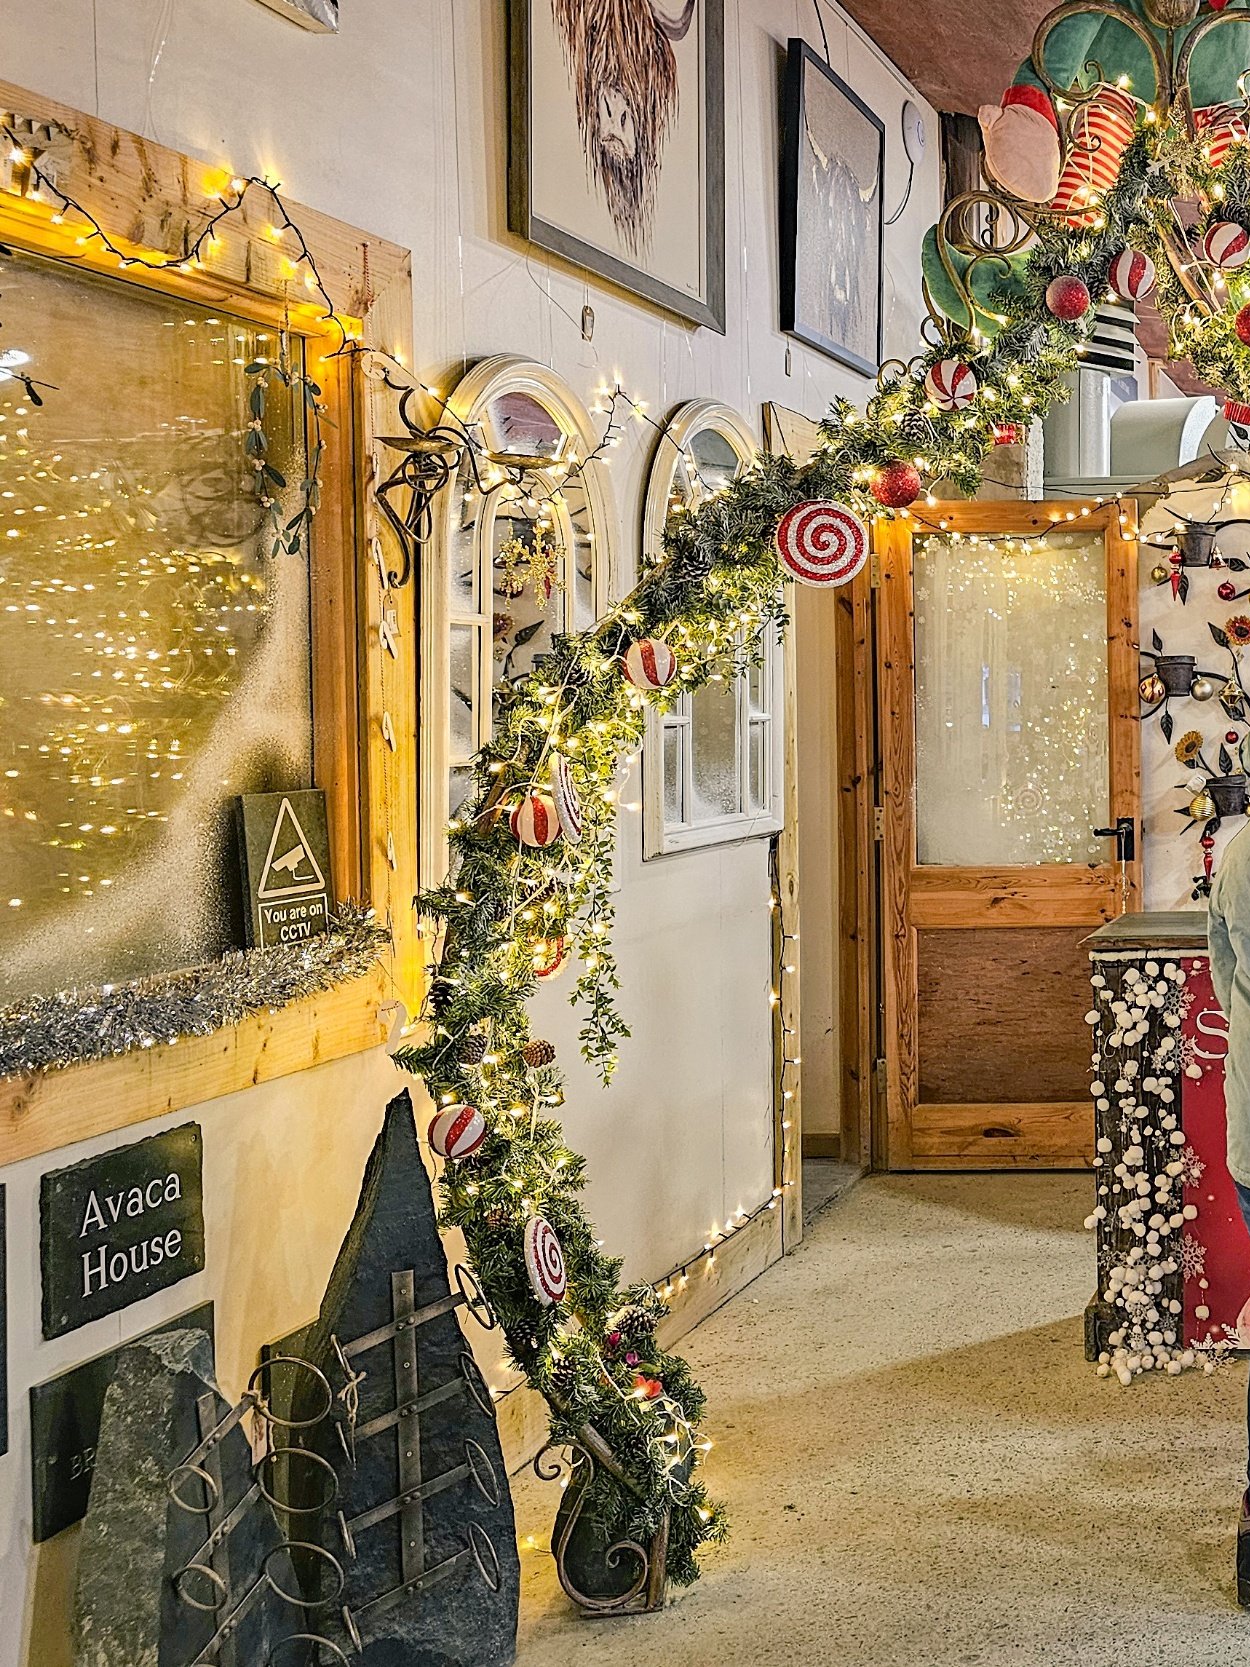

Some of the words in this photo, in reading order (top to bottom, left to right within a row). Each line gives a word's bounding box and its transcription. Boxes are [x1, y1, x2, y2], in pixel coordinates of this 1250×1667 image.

[264, 908, 287, 924] You
[289, 907, 307, 920] are
[310, 903, 323, 917] on
[280, 921, 311, 941] CCTV
[79, 1172, 182, 1238] Avaca
[81, 1228, 182, 1298] House
